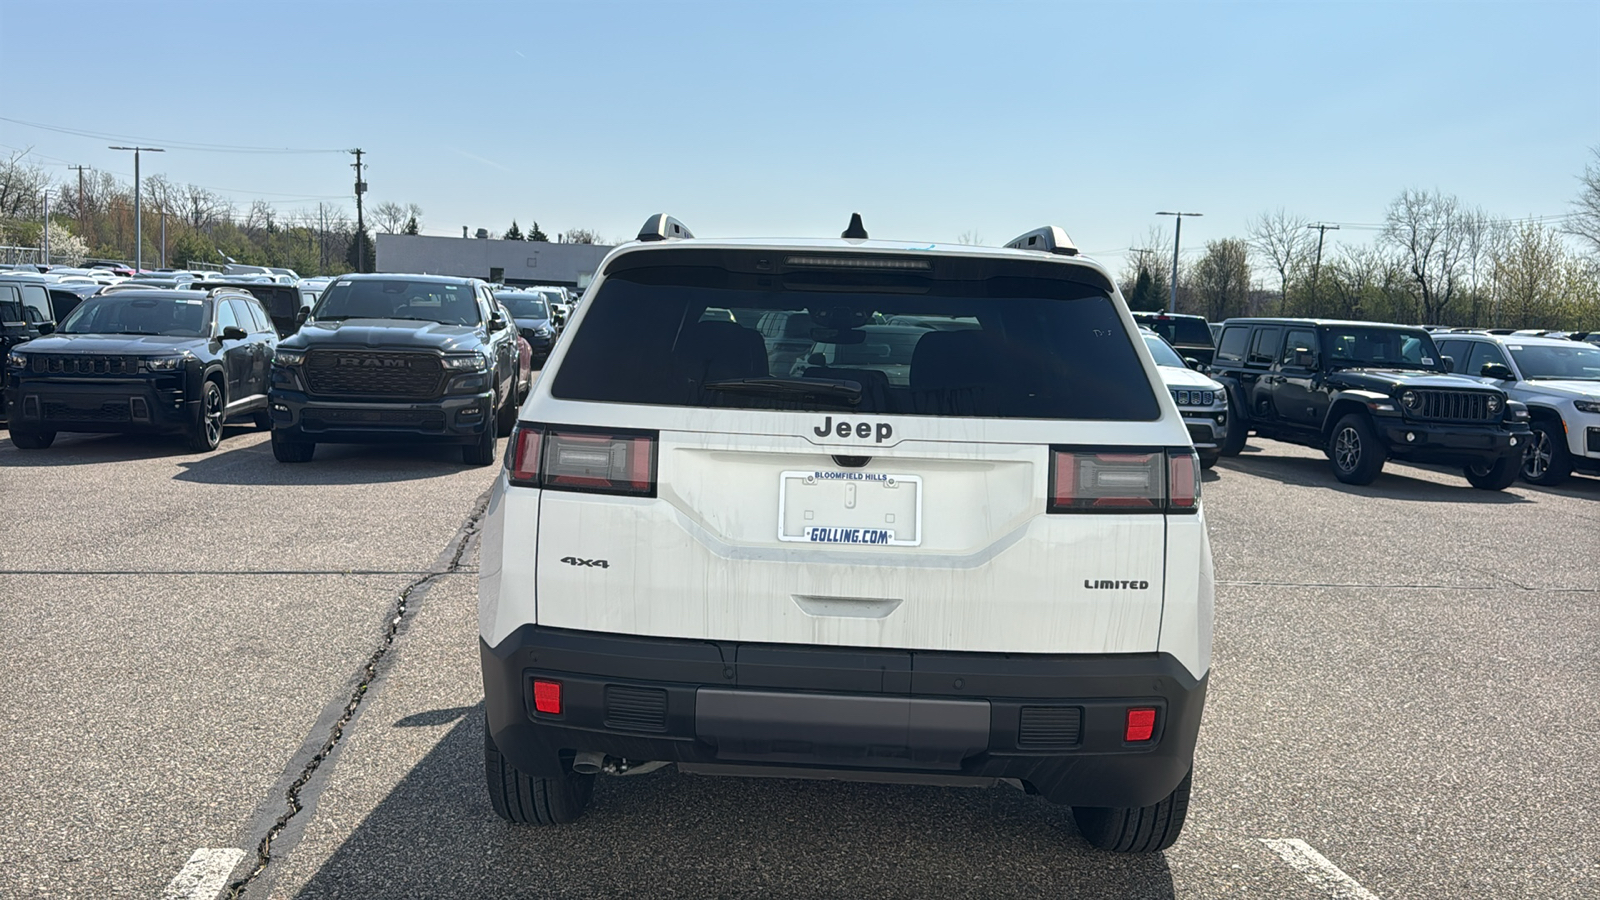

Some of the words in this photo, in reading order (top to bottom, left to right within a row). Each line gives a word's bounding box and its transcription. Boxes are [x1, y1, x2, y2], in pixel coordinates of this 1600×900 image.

[340, 357, 405, 367] RAM
[814, 416, 893, 443] Jeep
[815, 472, 863, 480] BLOOMFIELD
[865, 473, 887, 481] HILLS
[810, 528, 888, 544] GOLLING.COM
[1084, 579, 1149, 590] LIMITED
